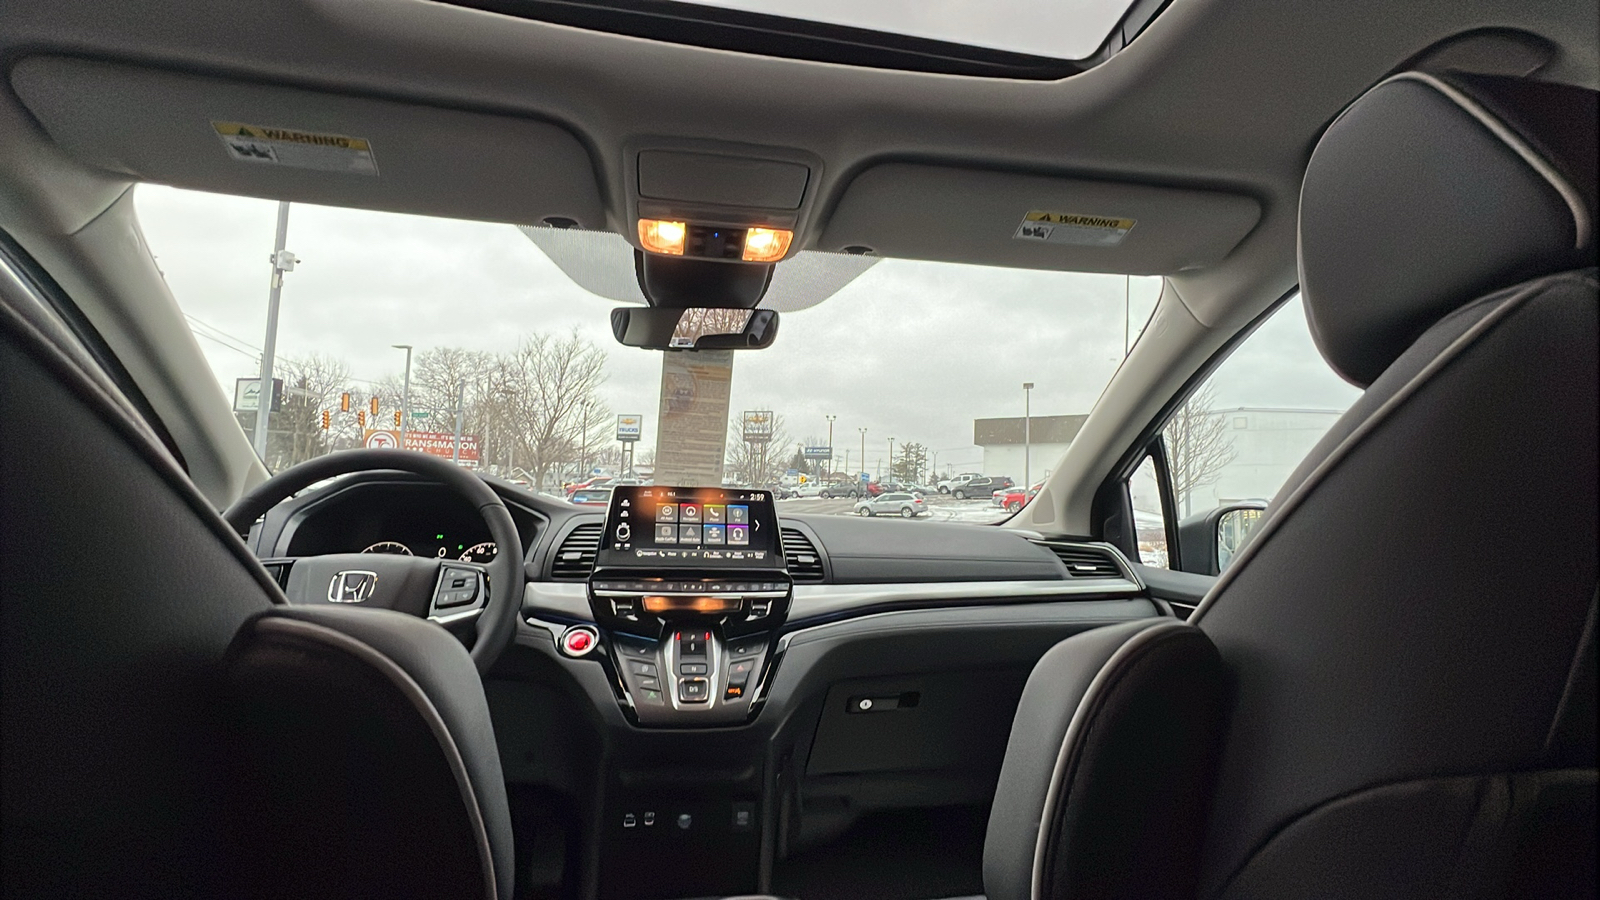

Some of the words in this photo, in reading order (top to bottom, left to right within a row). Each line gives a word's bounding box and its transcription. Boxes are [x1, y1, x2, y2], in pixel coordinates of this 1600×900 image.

[262, 128, 350, 148] WARNING
[1058, 215, 1120, 228] WARNING
[403, 438, 477, 450] RANS4MAION
[750, 493, 765, 501] 2:59
